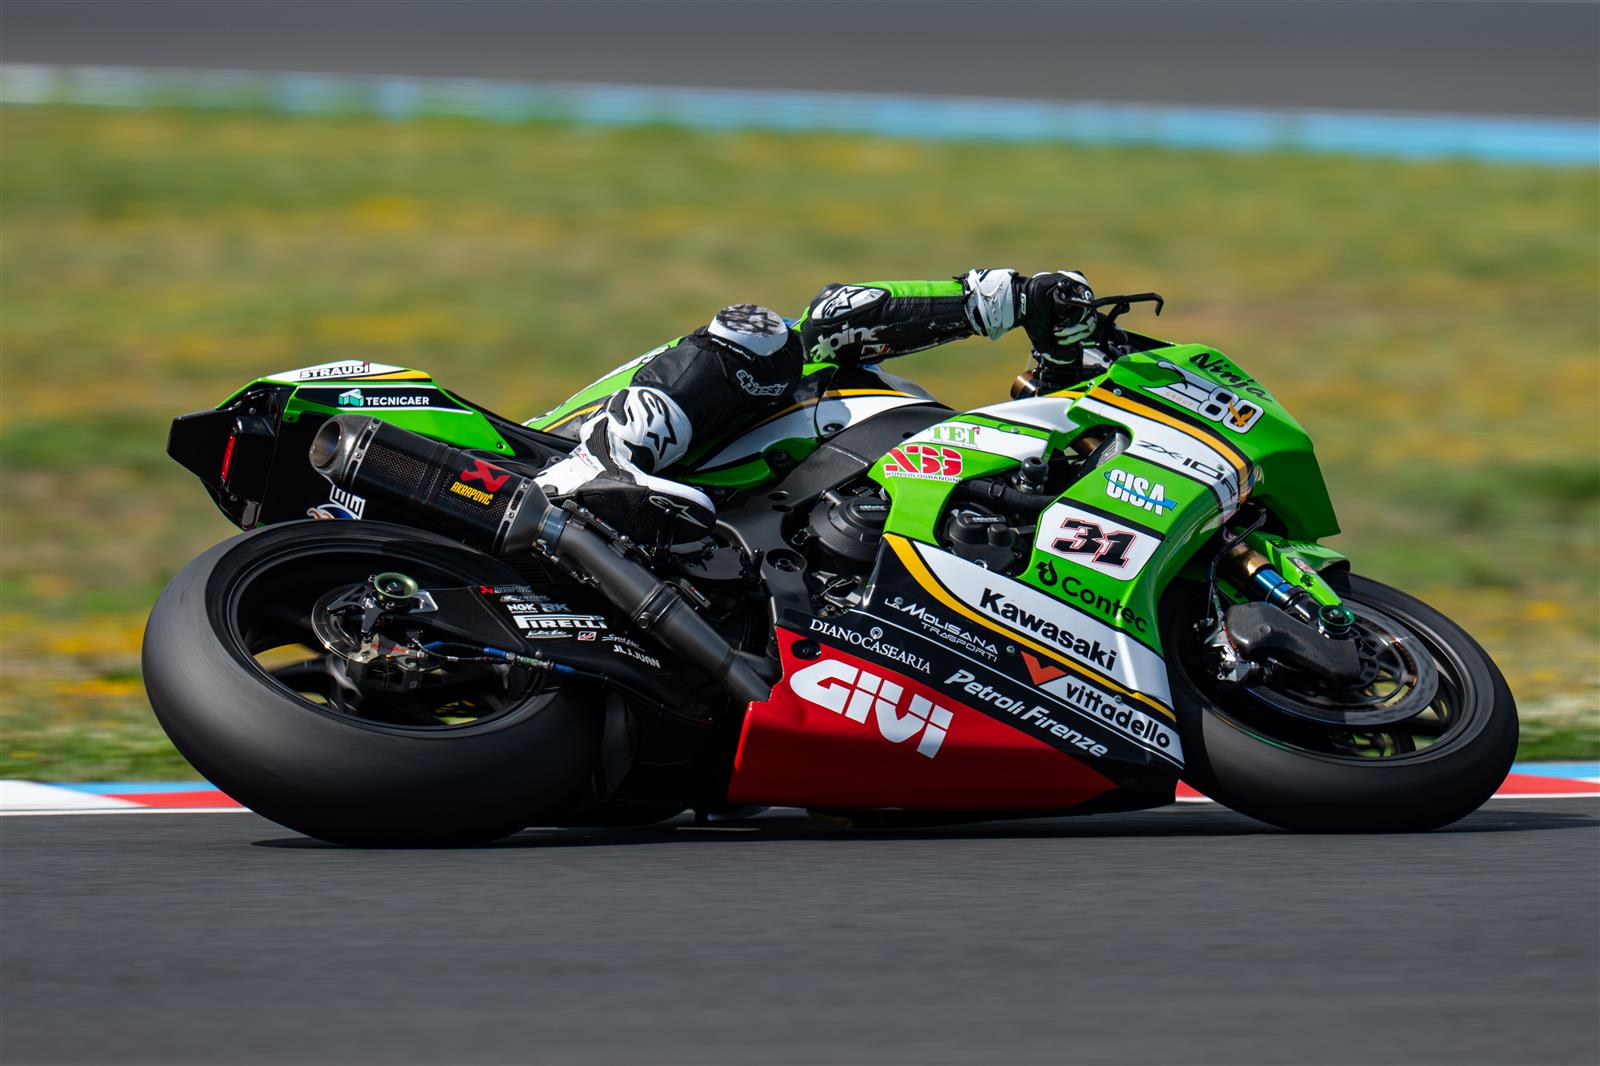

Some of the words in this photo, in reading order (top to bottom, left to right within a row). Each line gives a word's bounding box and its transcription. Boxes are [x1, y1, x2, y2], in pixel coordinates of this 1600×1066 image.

[366, 396, 430, 406] TECNICAER
[1188, 352, 1272, 402] Ninja
[1105, 468, 1165, 516] CISA
[1051, 517, 1137, 568] 31
[506, 603, 537, 611] NGK
[512, 613, 608, 629] PIRELLI
[1062, 576, 1148, 633] Contec
[921, 621, 998, 662] TRASPORTI
[977, 588, 1117, 671] Kawasaki
[944, 668, 1025, 717] Petroli
[1020, 704, 1109, 757] Firenze
